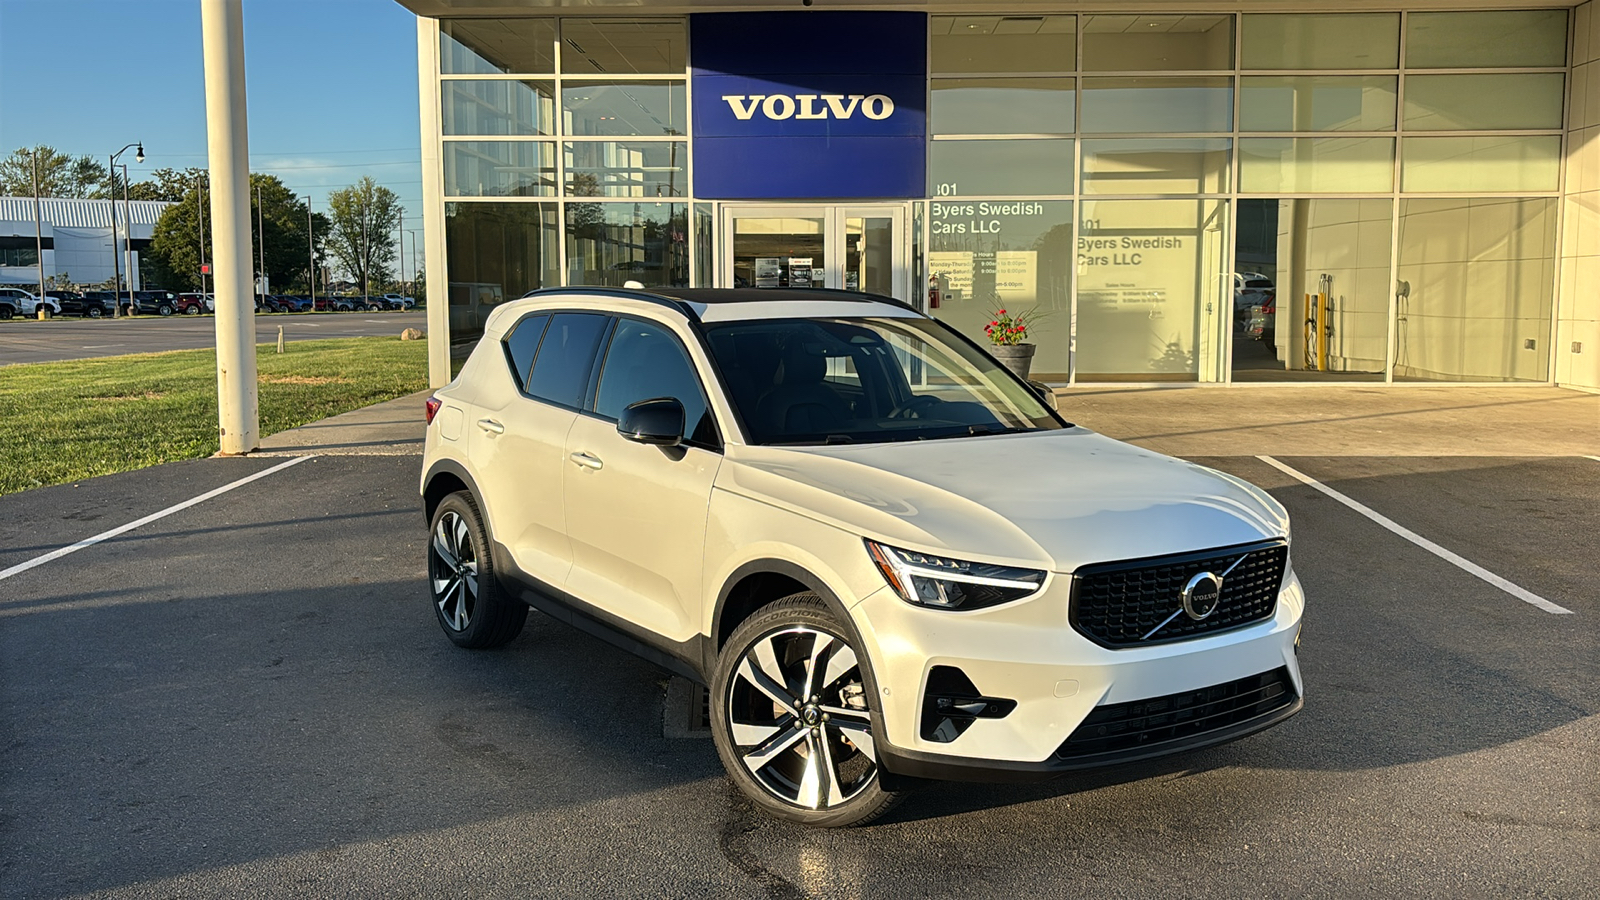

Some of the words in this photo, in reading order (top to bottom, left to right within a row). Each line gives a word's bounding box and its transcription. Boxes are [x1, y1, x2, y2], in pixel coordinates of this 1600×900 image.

[722, 94, 895, 121] VOLVO
[933, 203, 974, 219] Byers
[979, 202, 1043, 215] Swedish
[933, 220, 966, 234] Cars
[971, 220, 1001, 233] LLC
[1078, 238, 1117, 252] Byers
[1121, 237, 1182, 249] Swedish
[1113, 253, 1142, 265] LLC
[1193, 593, 1217, 601] VOLVO
[756, 610, 820, 627] SCORPION
